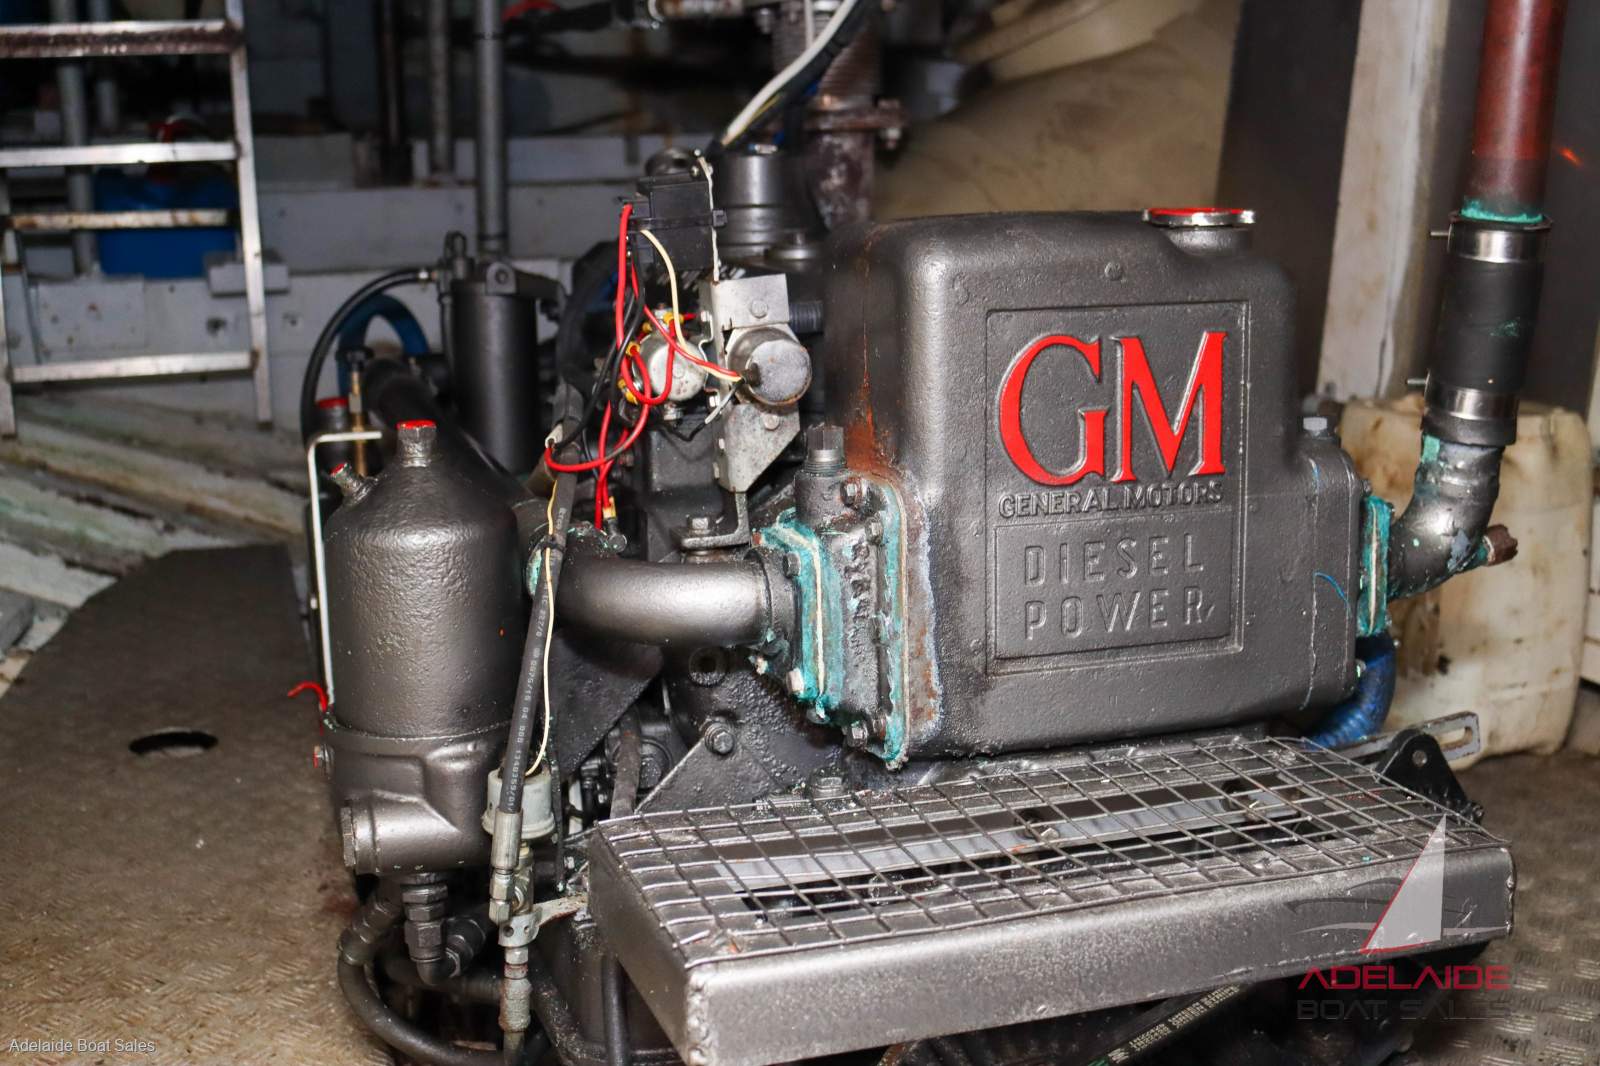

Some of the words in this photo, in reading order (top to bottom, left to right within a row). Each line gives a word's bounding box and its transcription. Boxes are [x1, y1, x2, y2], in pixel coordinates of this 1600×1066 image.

[996, 330, 1228, 487] GM
[999, 489, 1121, 519] GENERAL
[1123, 480, 1223, 509] MOTORS
[1024, 532, 1204, 587] DIESEL
[1024, 585, 1204, 641] POWER
